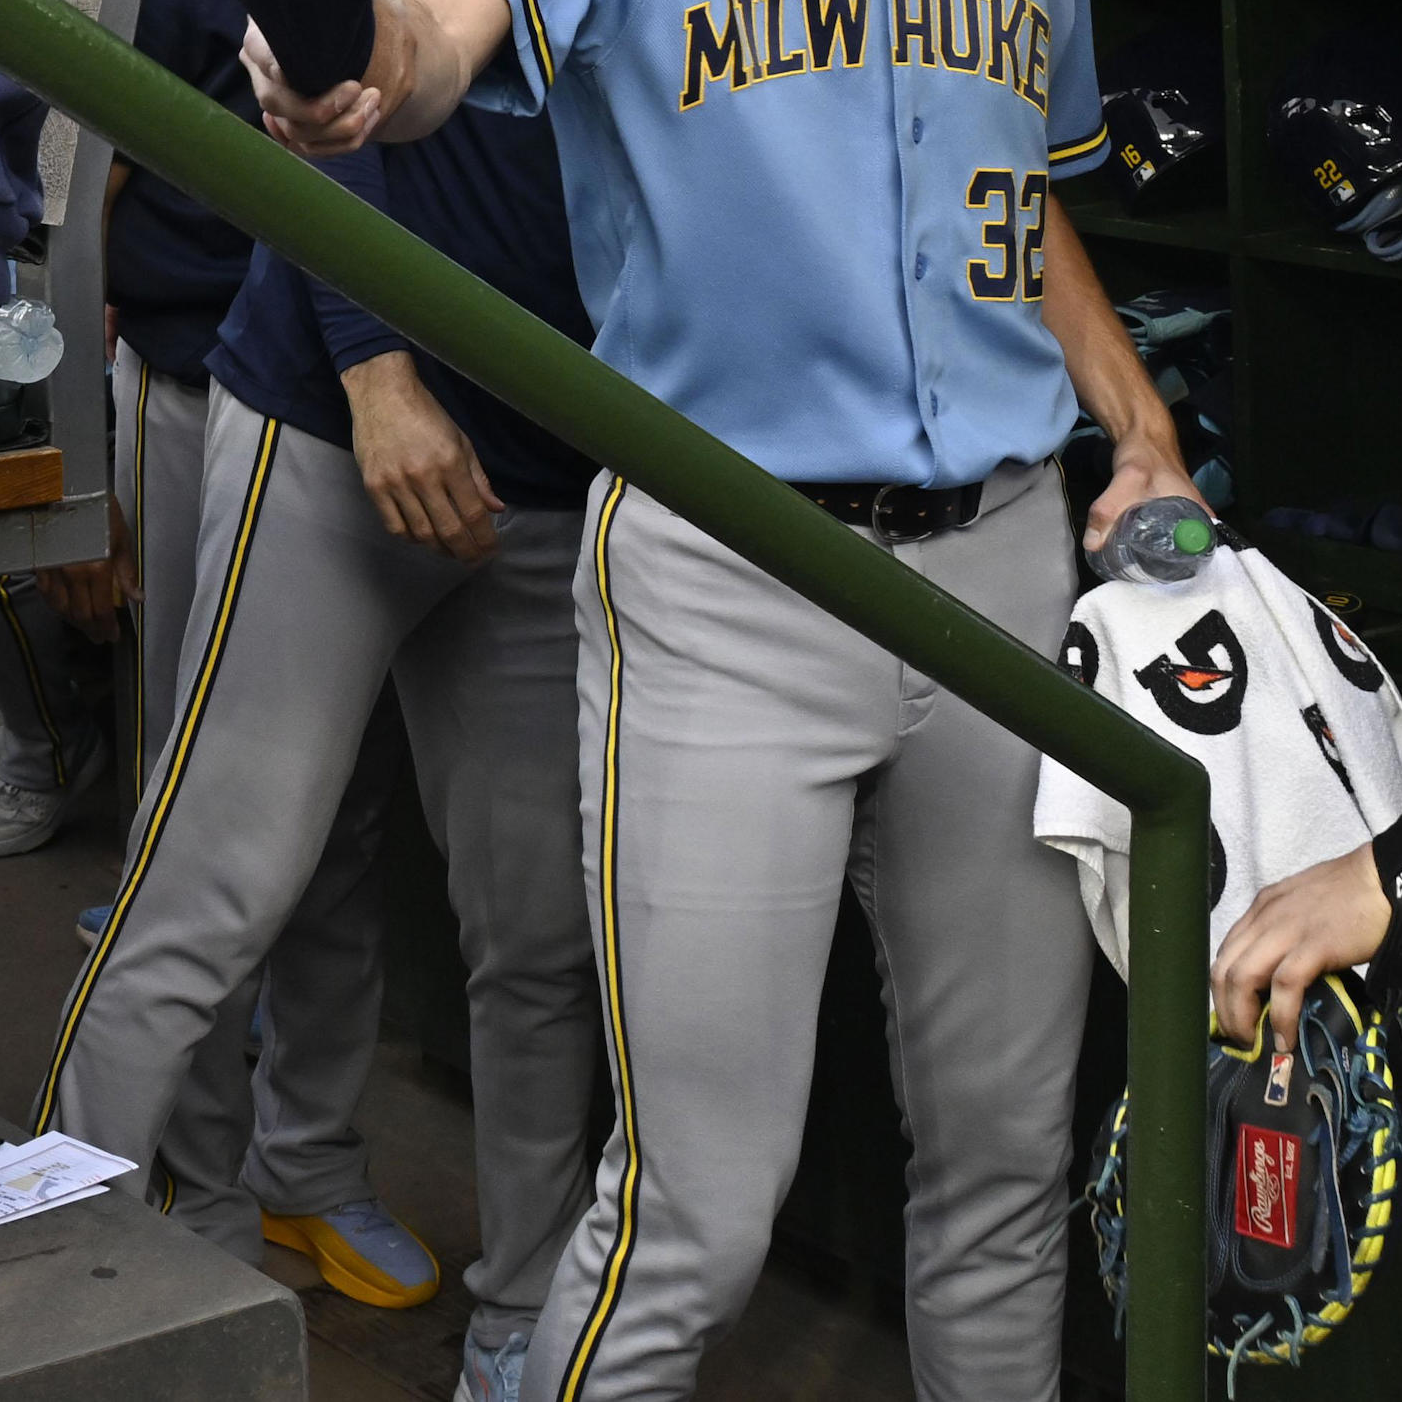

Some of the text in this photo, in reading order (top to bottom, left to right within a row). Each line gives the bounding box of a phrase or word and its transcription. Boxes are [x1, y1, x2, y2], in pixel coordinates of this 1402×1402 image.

[1120, 143, 1142, 169] 16
[1313, 158, 1343, 189] 22
[966, 168, 1049, 302] 32
[1249, 1138, 1275, 1234] Rawlings
